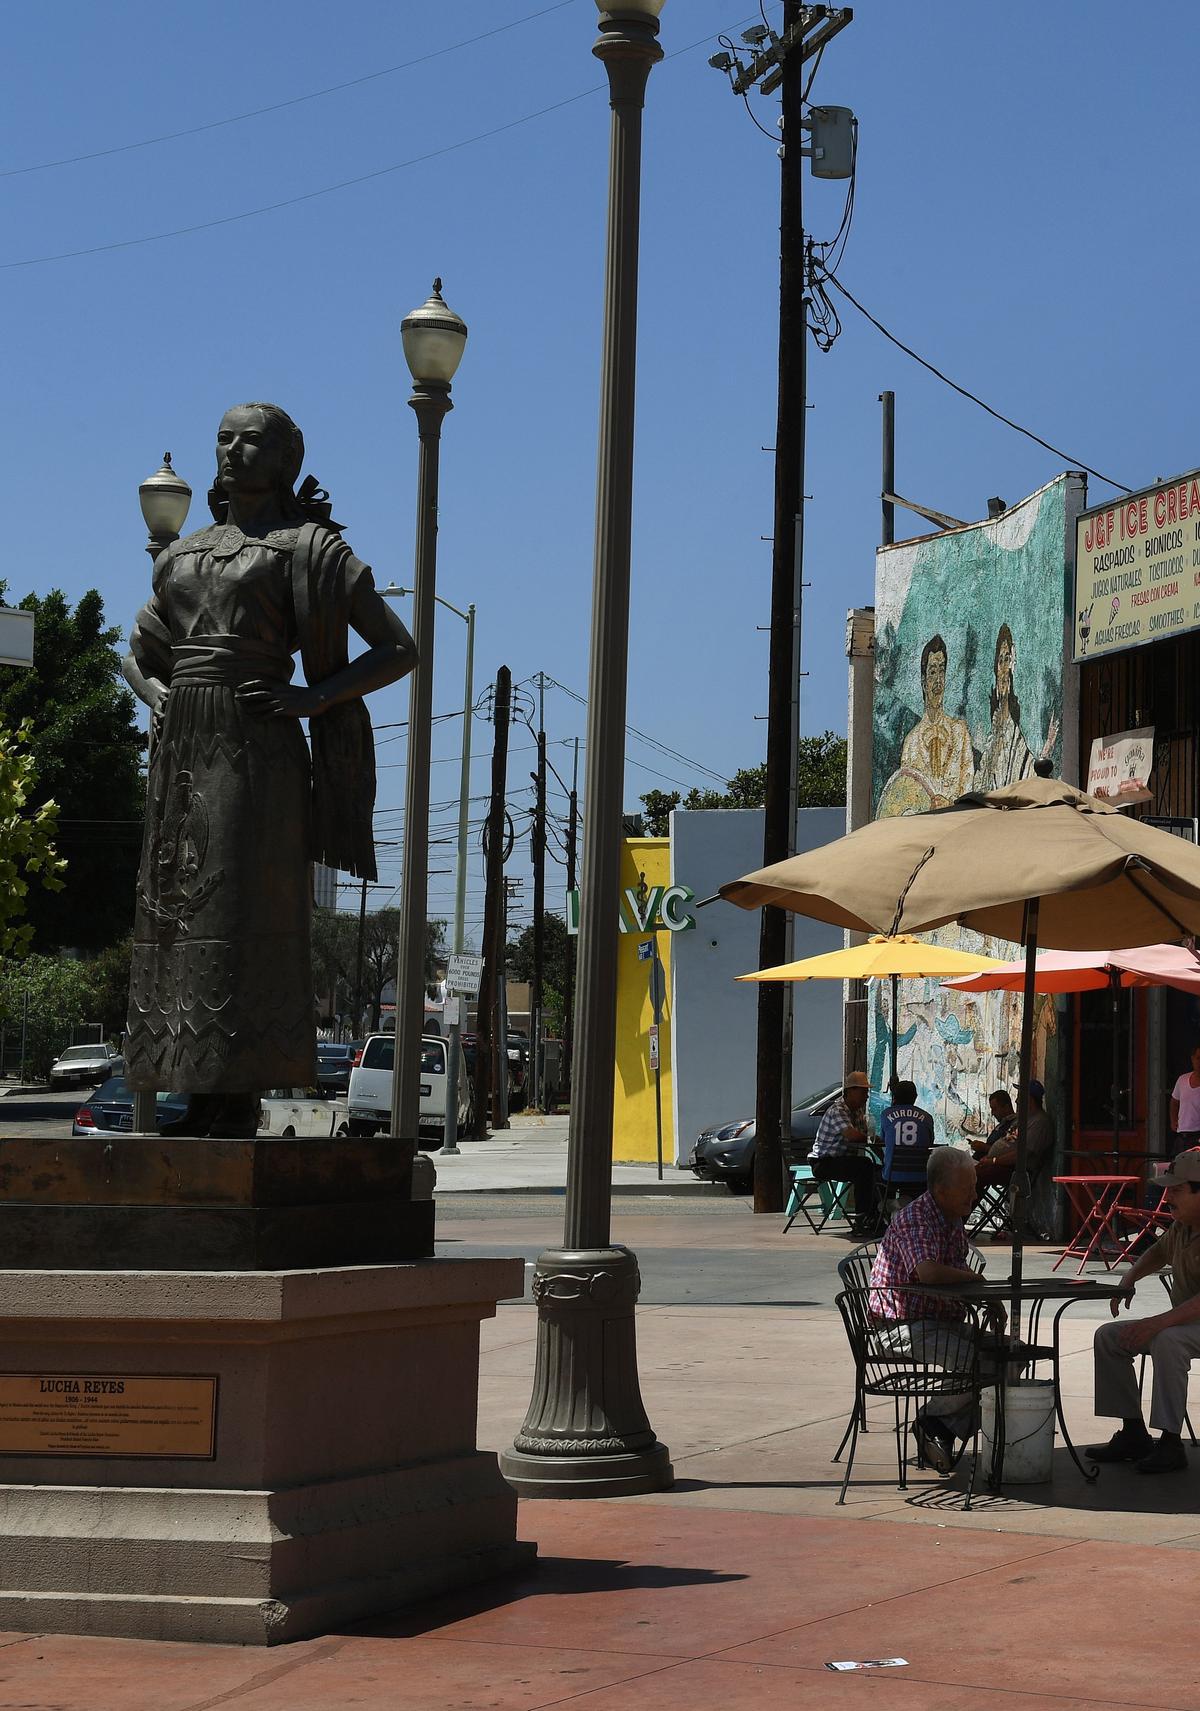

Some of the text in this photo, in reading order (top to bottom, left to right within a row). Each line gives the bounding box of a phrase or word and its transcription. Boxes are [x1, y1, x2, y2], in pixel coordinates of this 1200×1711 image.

[1085, 510, 1115, 552] J&F
[1120, 497, 1149, 541] ICE
[1093, 544, 1135, 575] RASPADOS
[1145, 529, 1183, 558] BIONICOS
[1090, 575, 1109, 599] JUGOS
[1109, 568, 1142, 595] NATURALES
[1149, 555, 1184, 583] TOSTILOCOS
[1131, 589, 1150, 608] FRESAS
[1150, 587, 1161, 603] CON
[1160, 581, 1179, 600] CREMA
[1094, 626, 1114, 647] AGUAS
[1114, 619, 1141, 643] FRESCAS
[1149, 607, 1185, 632] SMOOTHIES
[1090, 765, 1118, 781] PROUD TO
[453, 957, 479, 966] VEHICLES
[449, 968, 461, 976] 6000
[448, 980, 478, 989] PROHIBITED
[887, 1109, 926, 1123] KURODA
[894, 1121, 918, 1146] 18
[40, 1380, 125, 1394] LUCHA REYES
